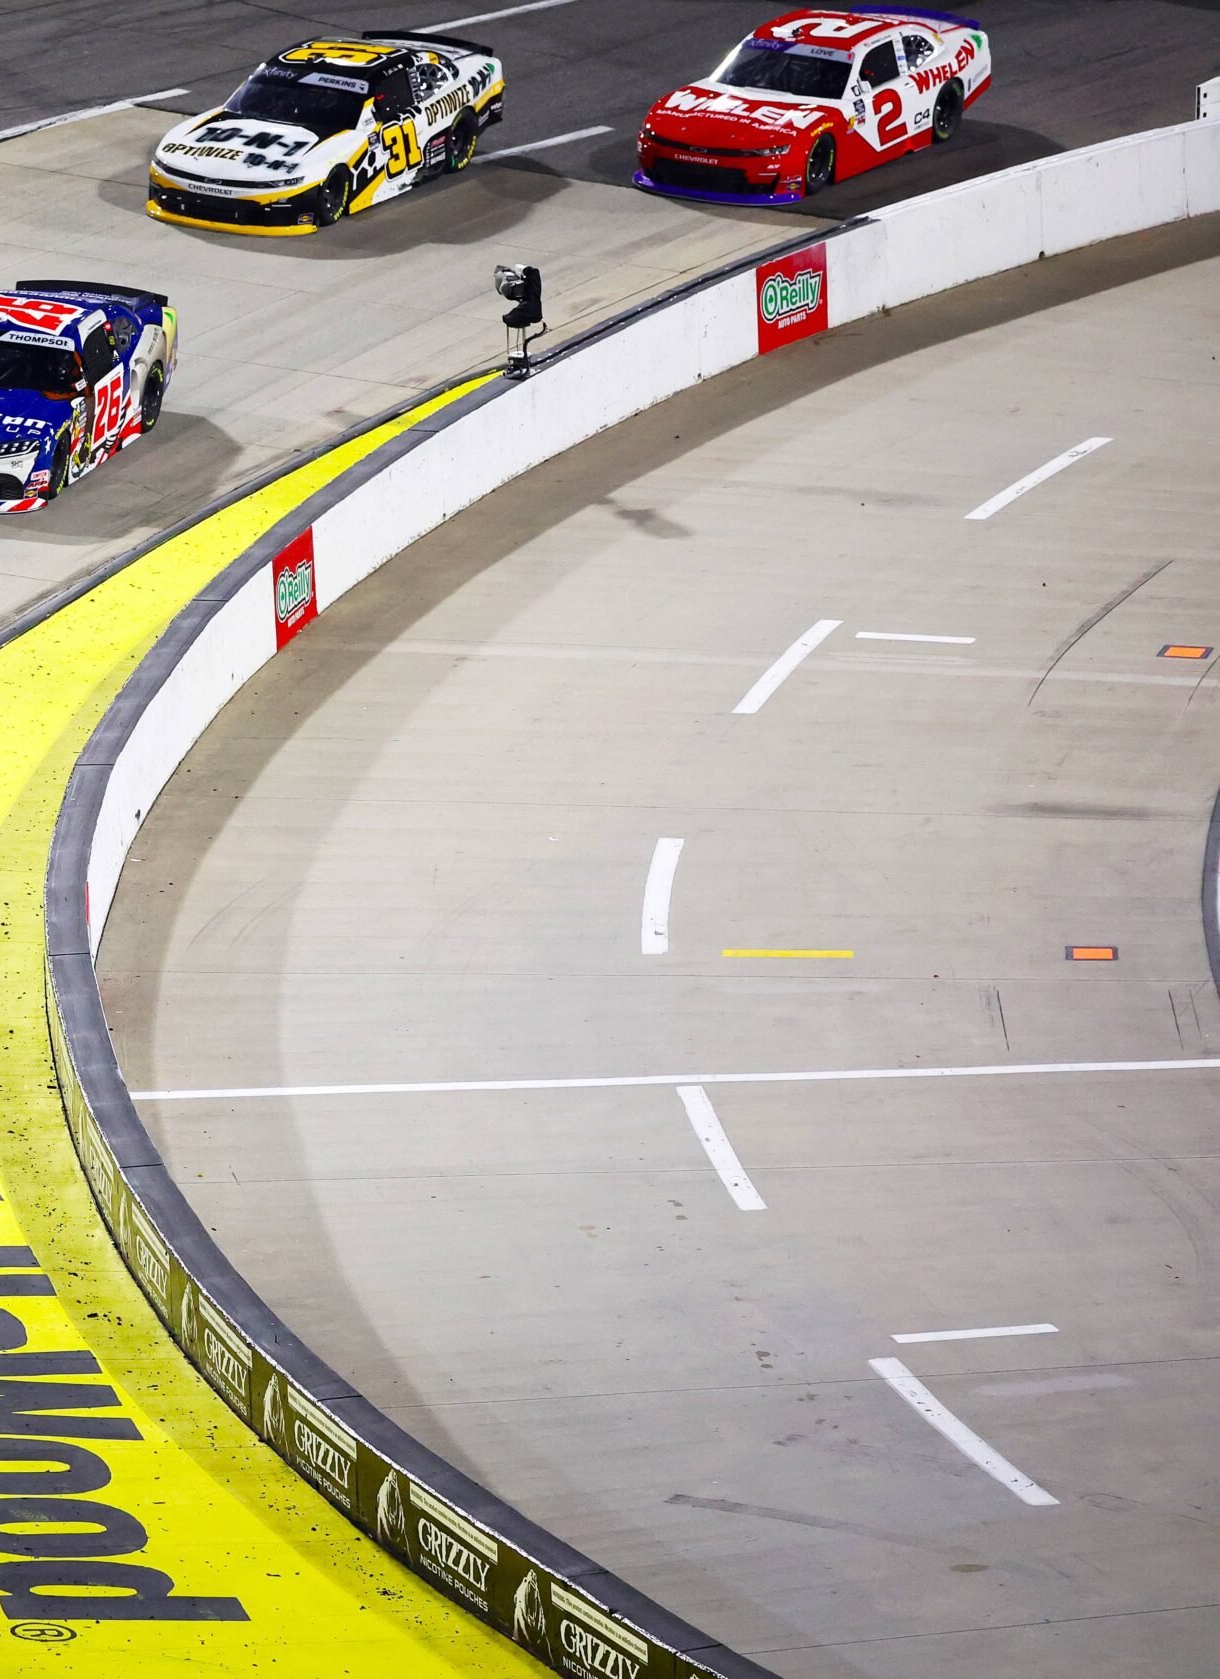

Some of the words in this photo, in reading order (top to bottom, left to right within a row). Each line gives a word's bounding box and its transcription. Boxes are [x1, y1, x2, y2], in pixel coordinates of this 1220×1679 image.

[811, 49, 834, 57] LOVE
[909, 39, 975, 94] WHELEN
[318, 76, 357, 88] PERKINS
[665, 90, 825, 130] WHELEN
[751, 123, 797, 137] AMERICA
[872, 89, 908, 146] 2
[914, 108, 930, 125] C4
[382, 119, 422, 174] 31
[674, 154, 718, 165] CHEVROLET
[188, 183, 233, 195] CHEVROLET
[763, 274, 820, 319] O'Reilly
[93, 376, 121, 444] 26
[278, 566, 310, 619] O'Reilly
[136, 1234, 168, 1300] GRIZZLY
[204, 1327, 248, 1397] GRIZZLY
[294, 1419, 351, 1489] GRIZZLY
[296, 1455, 323, 1486] NICOTINE
[323, 1477, 351, 1509] POUCHES
[417, 1517, 490, 1592] GRIZZLY
[419, 1552, 454, 1587] NICOTINE
[454, 1577, 489, 1612] POUCHES
[560, 1619, 640, 1679] GRIZZLY
